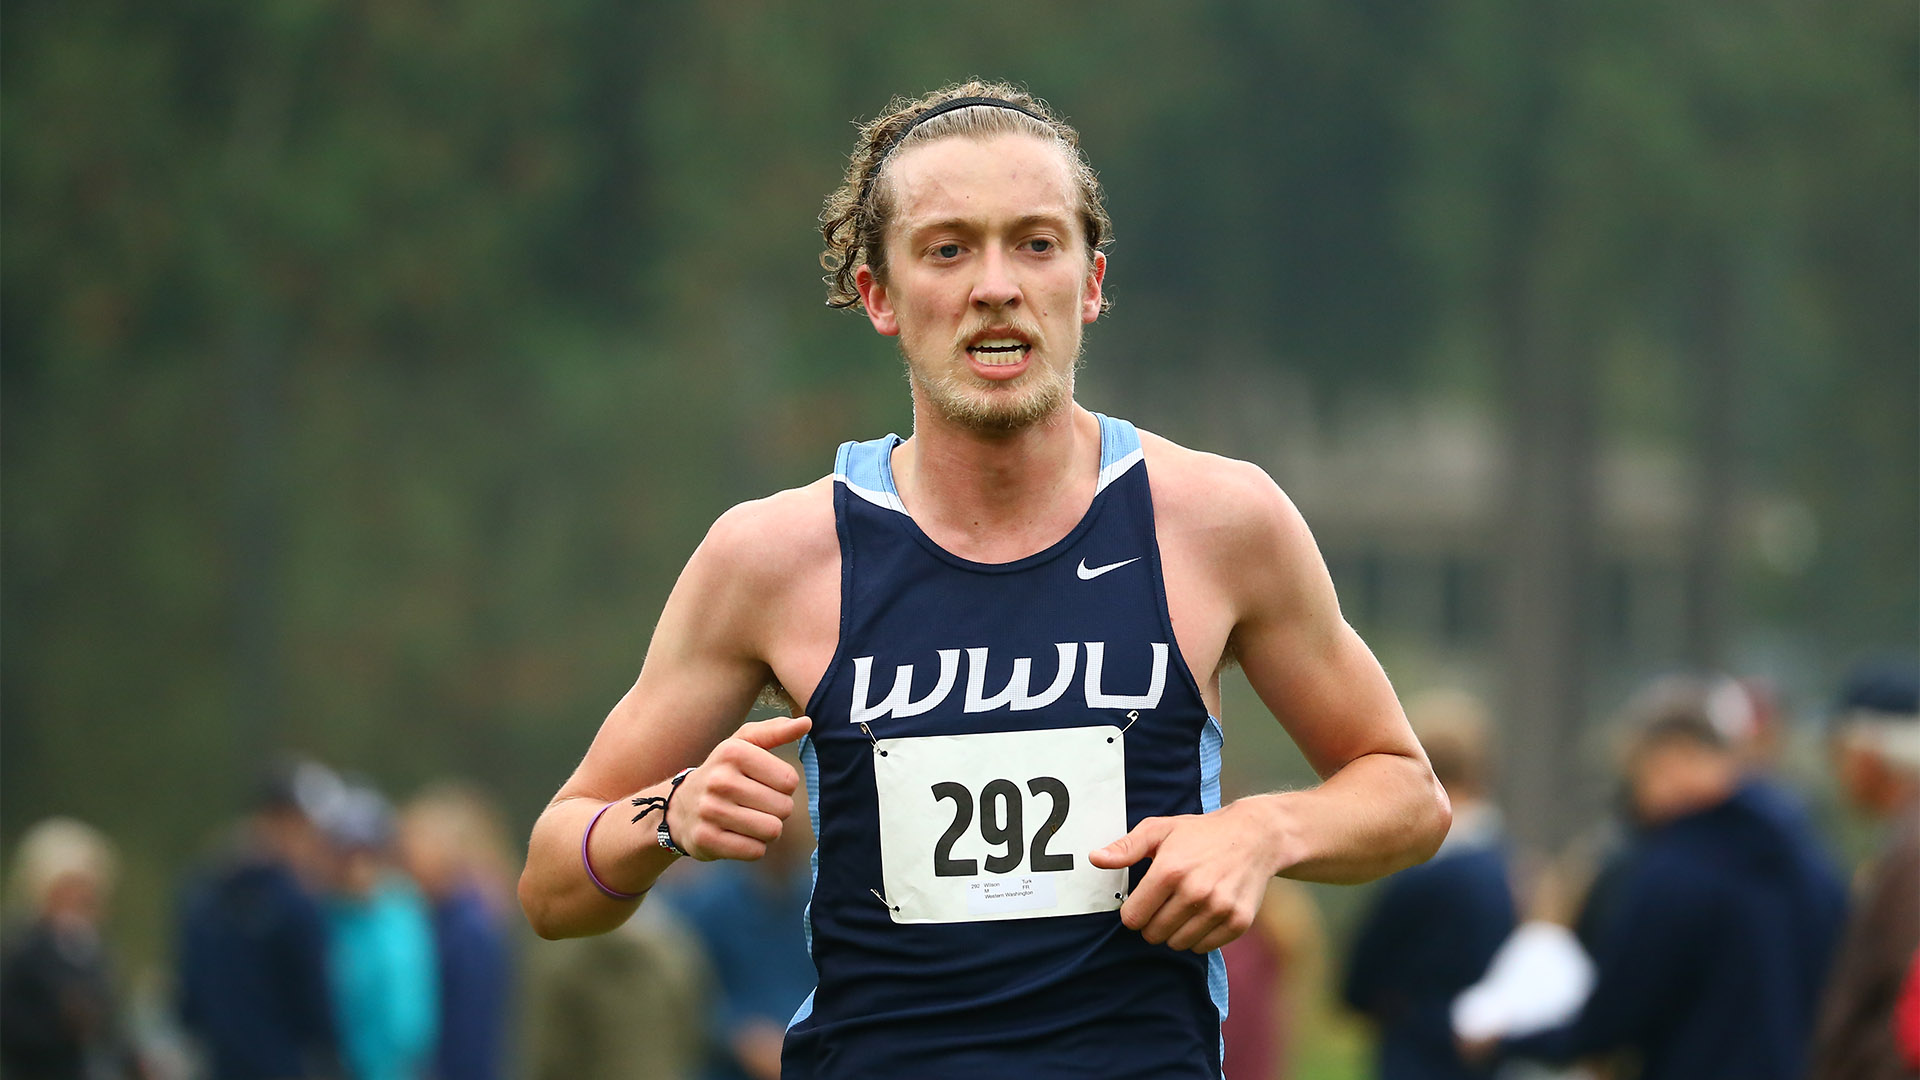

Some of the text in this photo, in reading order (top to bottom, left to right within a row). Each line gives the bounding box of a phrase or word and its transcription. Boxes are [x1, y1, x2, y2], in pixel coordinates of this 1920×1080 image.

[849, 641, 1169, 724] WWU
[930, 776, 1074, 877] 292
[1005, 890, 1033, 898] Washington
